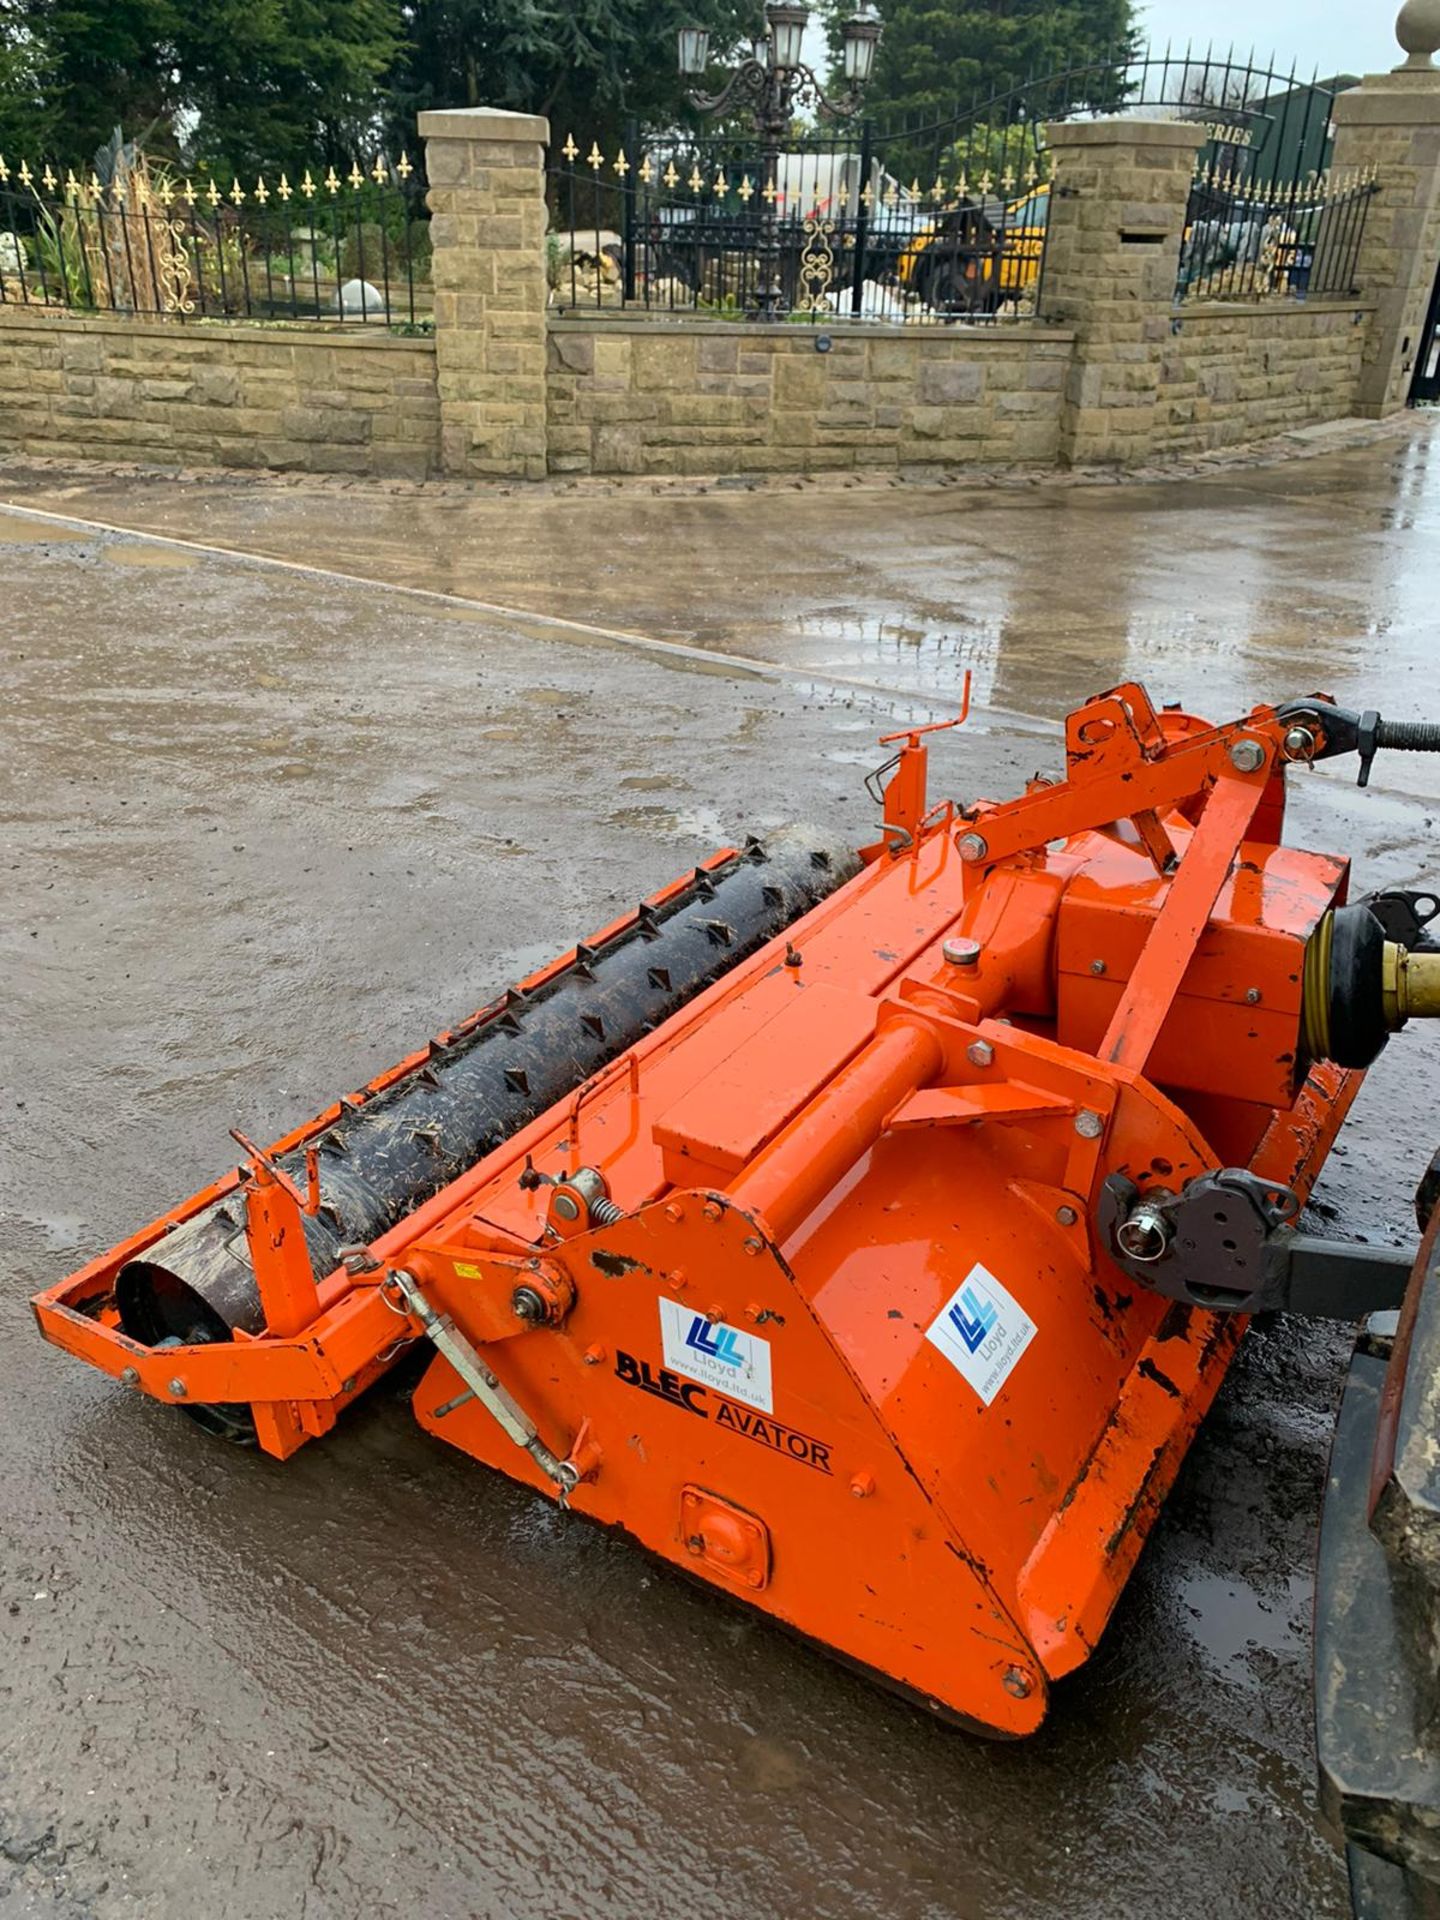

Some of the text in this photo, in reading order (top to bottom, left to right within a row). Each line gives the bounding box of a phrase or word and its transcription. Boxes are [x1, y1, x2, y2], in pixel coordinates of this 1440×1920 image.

[693, 1350, 737, 1379] Lloyd
[978, 1324, 1008, 1362] Lloyd
[982, 1321, 1032, 1394] www.lloyd.ltd.uk
[670, 1356, 767, 1406] www.lloyd.ltd.uk
